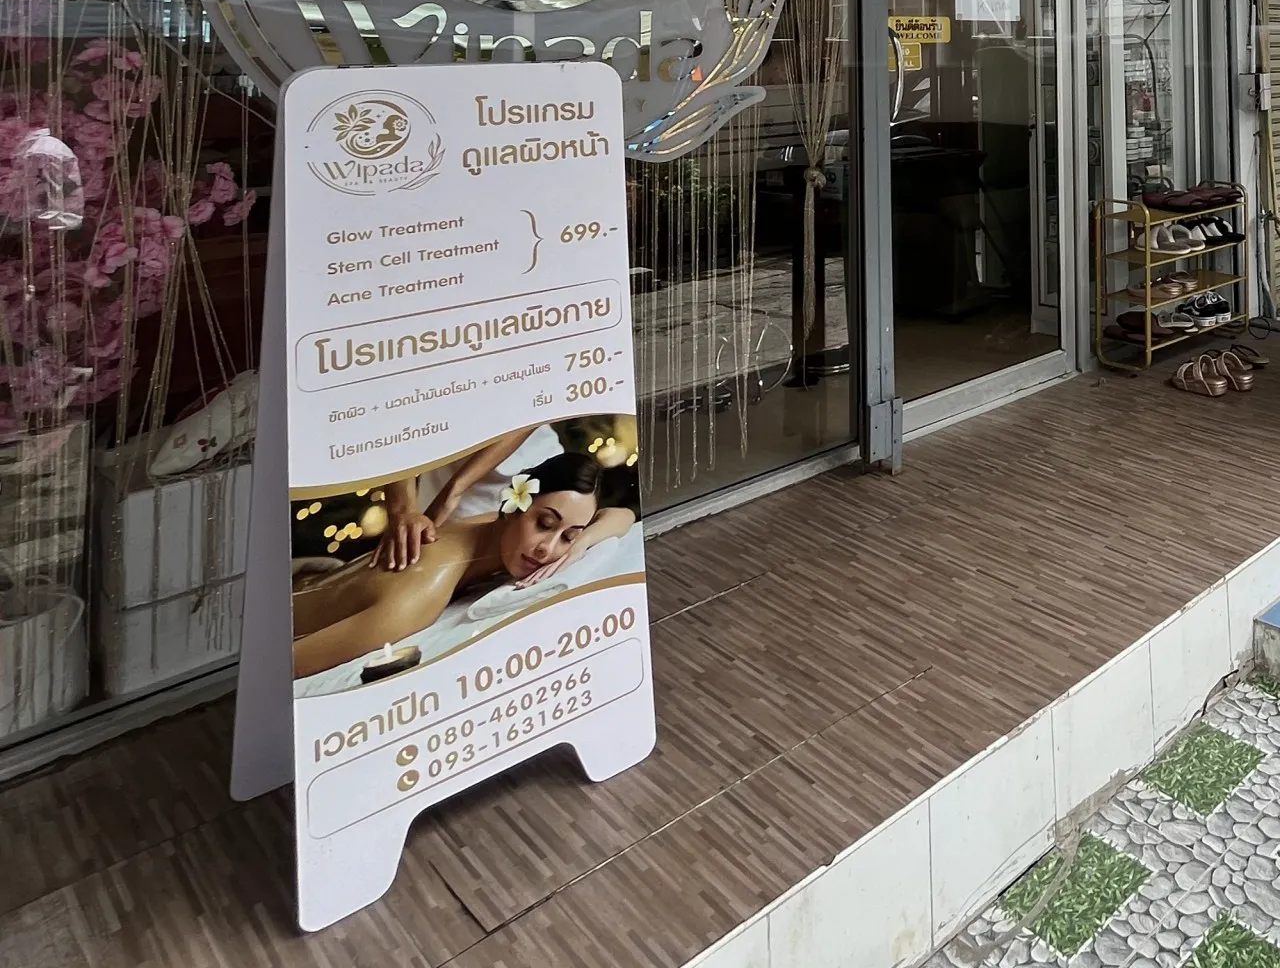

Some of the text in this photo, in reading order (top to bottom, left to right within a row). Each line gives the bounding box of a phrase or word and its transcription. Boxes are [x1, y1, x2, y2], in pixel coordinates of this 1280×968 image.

[895, 19, 943, 31] ยินดีต้อนรับ
[896, 32, 943, 40] WELCOME
[475, 95, 595, 128] โปรแกรม
[323, 155, 424, 184] Wipada
[461, 131, 609, 176] ดูแลผิวหน้า
[326, 216, 465, 245] Glow Treatment
[560, 221, 618, 244] 699.-
[327, 239, 499, 275] Stem Cell Treatment
[326, 272, 465, 307] Acne Treatment
[314, 297, 611, 374] โปรแกรมดูแลผิวกาย
[328, 405, 366, 423] ขัดผิว
[564, 347, 623, 372] 750.-
[566, 376, 624, 402] 300.-
[314, 607, 636, 763] เวลาเปิด 10:00-20:00
[427, 666, 592, 753] 080-4602966
[428, 689, 593, 778] 093-1631623
